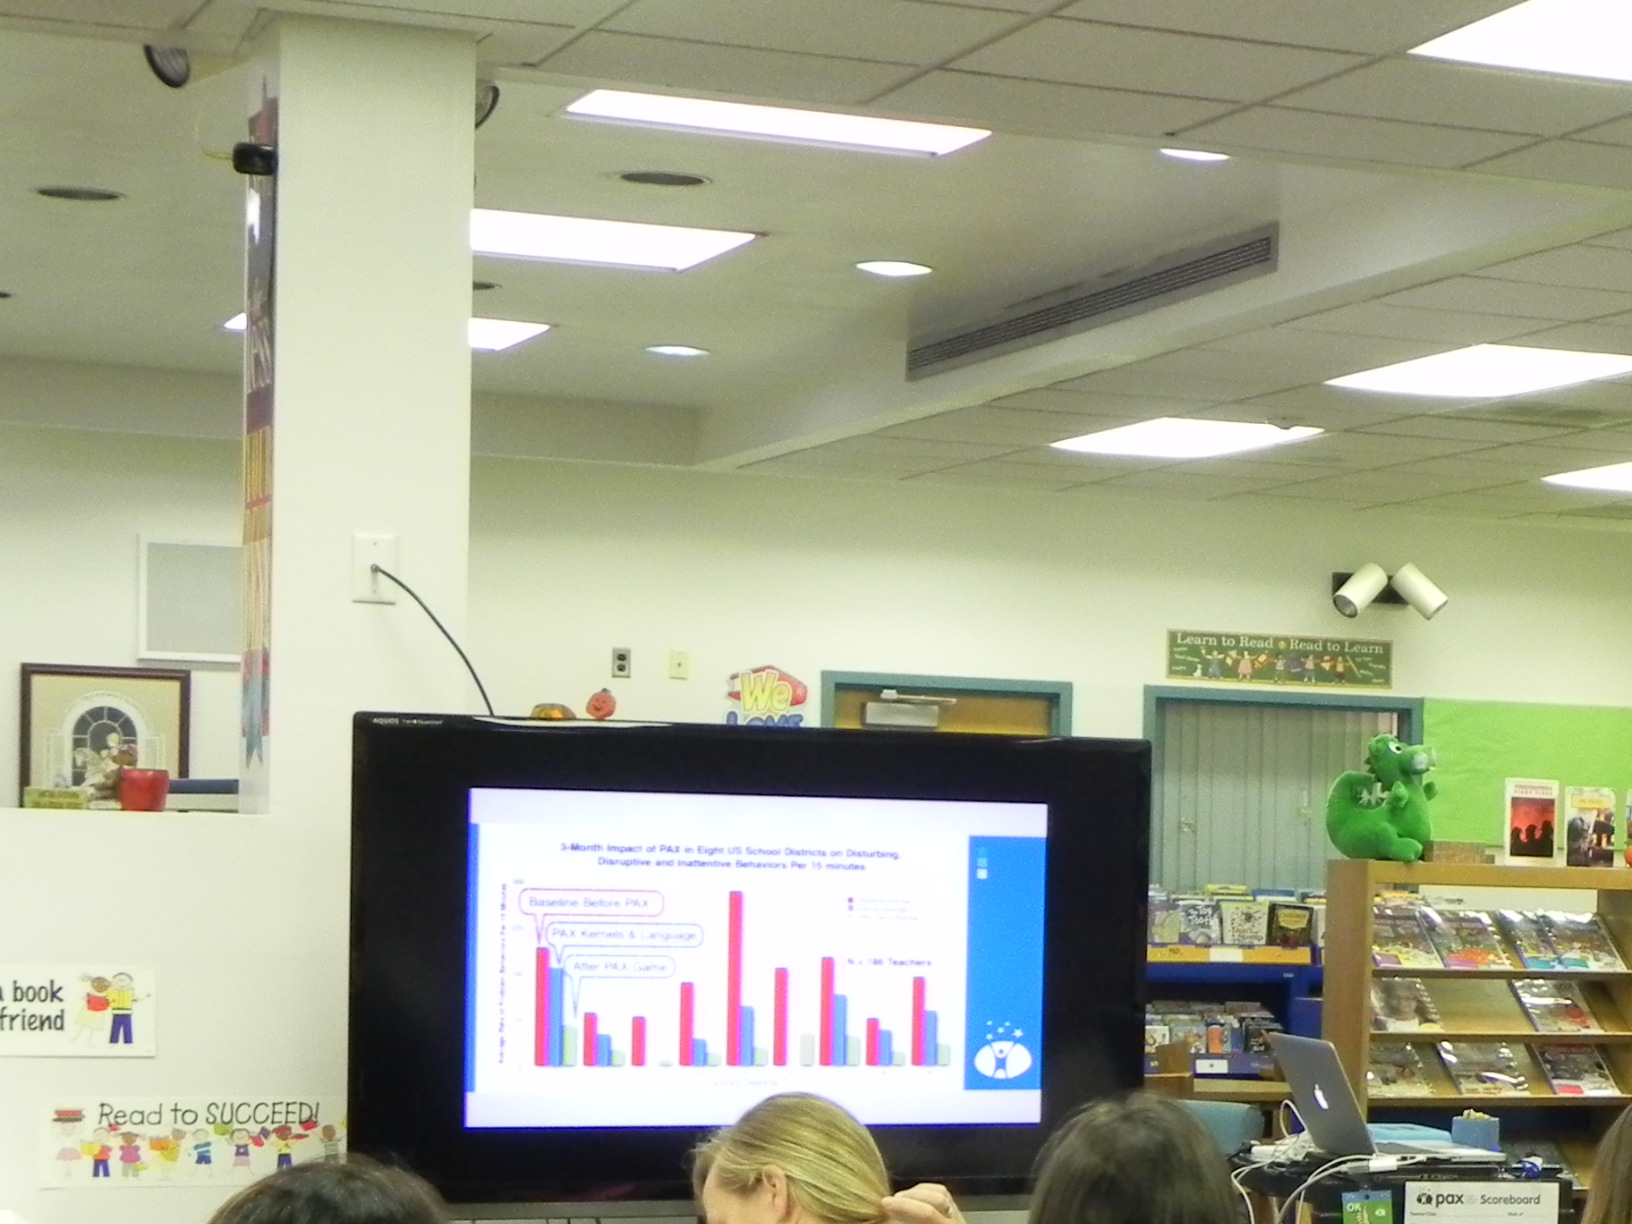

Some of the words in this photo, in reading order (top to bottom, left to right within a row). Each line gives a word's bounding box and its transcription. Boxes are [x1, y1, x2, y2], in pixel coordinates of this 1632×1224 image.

[1177, 633, 1217, 646] Learn
[1222, 635, 1236, 647] to
[1239, 636, 1274, 649] Read
[1290, 638, 1323, 651] Read
[1327, 640, 1341, 652] to
[1344, 641, 1384, 654] Learn
[741, 669, 790, 712] We
[560, 842, 604, 853] 3-Month
[607, 844, 643, 855] Impact
[646, 844, 657, 853] of
[660, 845, 681, 854] PAX
[697, 846, 725, 857] Eight
[727, 846, 742, 855] US
[745, 847, 782, 857] School
[785, 847, 827, 858] Districts
[830, 849, 843, 858] on
[597, 857, 652, 868] Disruptive
[655, 858, 675, 867] and
[678, 859, 732, 869] Inattentive
[735, 859, 787, 869] Behaviors
[791, 860, 808, 870] Per
[826, 862, 866, 871] minutes
[529, 896, 580, 908] Baseline
[583, 898, 622, 909] Before
[625, 898, 650, 908] PAX
[552, 927, 577, 938] PAX
[581, 928, 625, 940] Kernels
[641, 930, 698, 942] Language
[573, 962, 599, 972] After
[604, 962, 629, 972] PAX
[632, 962, 668, 973] Game
[887, 957, 932, 968] Teachers
[13, 979, 64, 1004] book
[0, 1006, 65, 1032] friend
[98, 1101, 163, 1126] Read
[171, 1102, 199, 1126] to
[206, 1101, 321, 1126] SUCCEED!
[1347, 1202, 1362, 1212] OK
[1435, 1193, 1465, 1208] pax
[1480, 1194, 1541, 1205] Scoreboard
